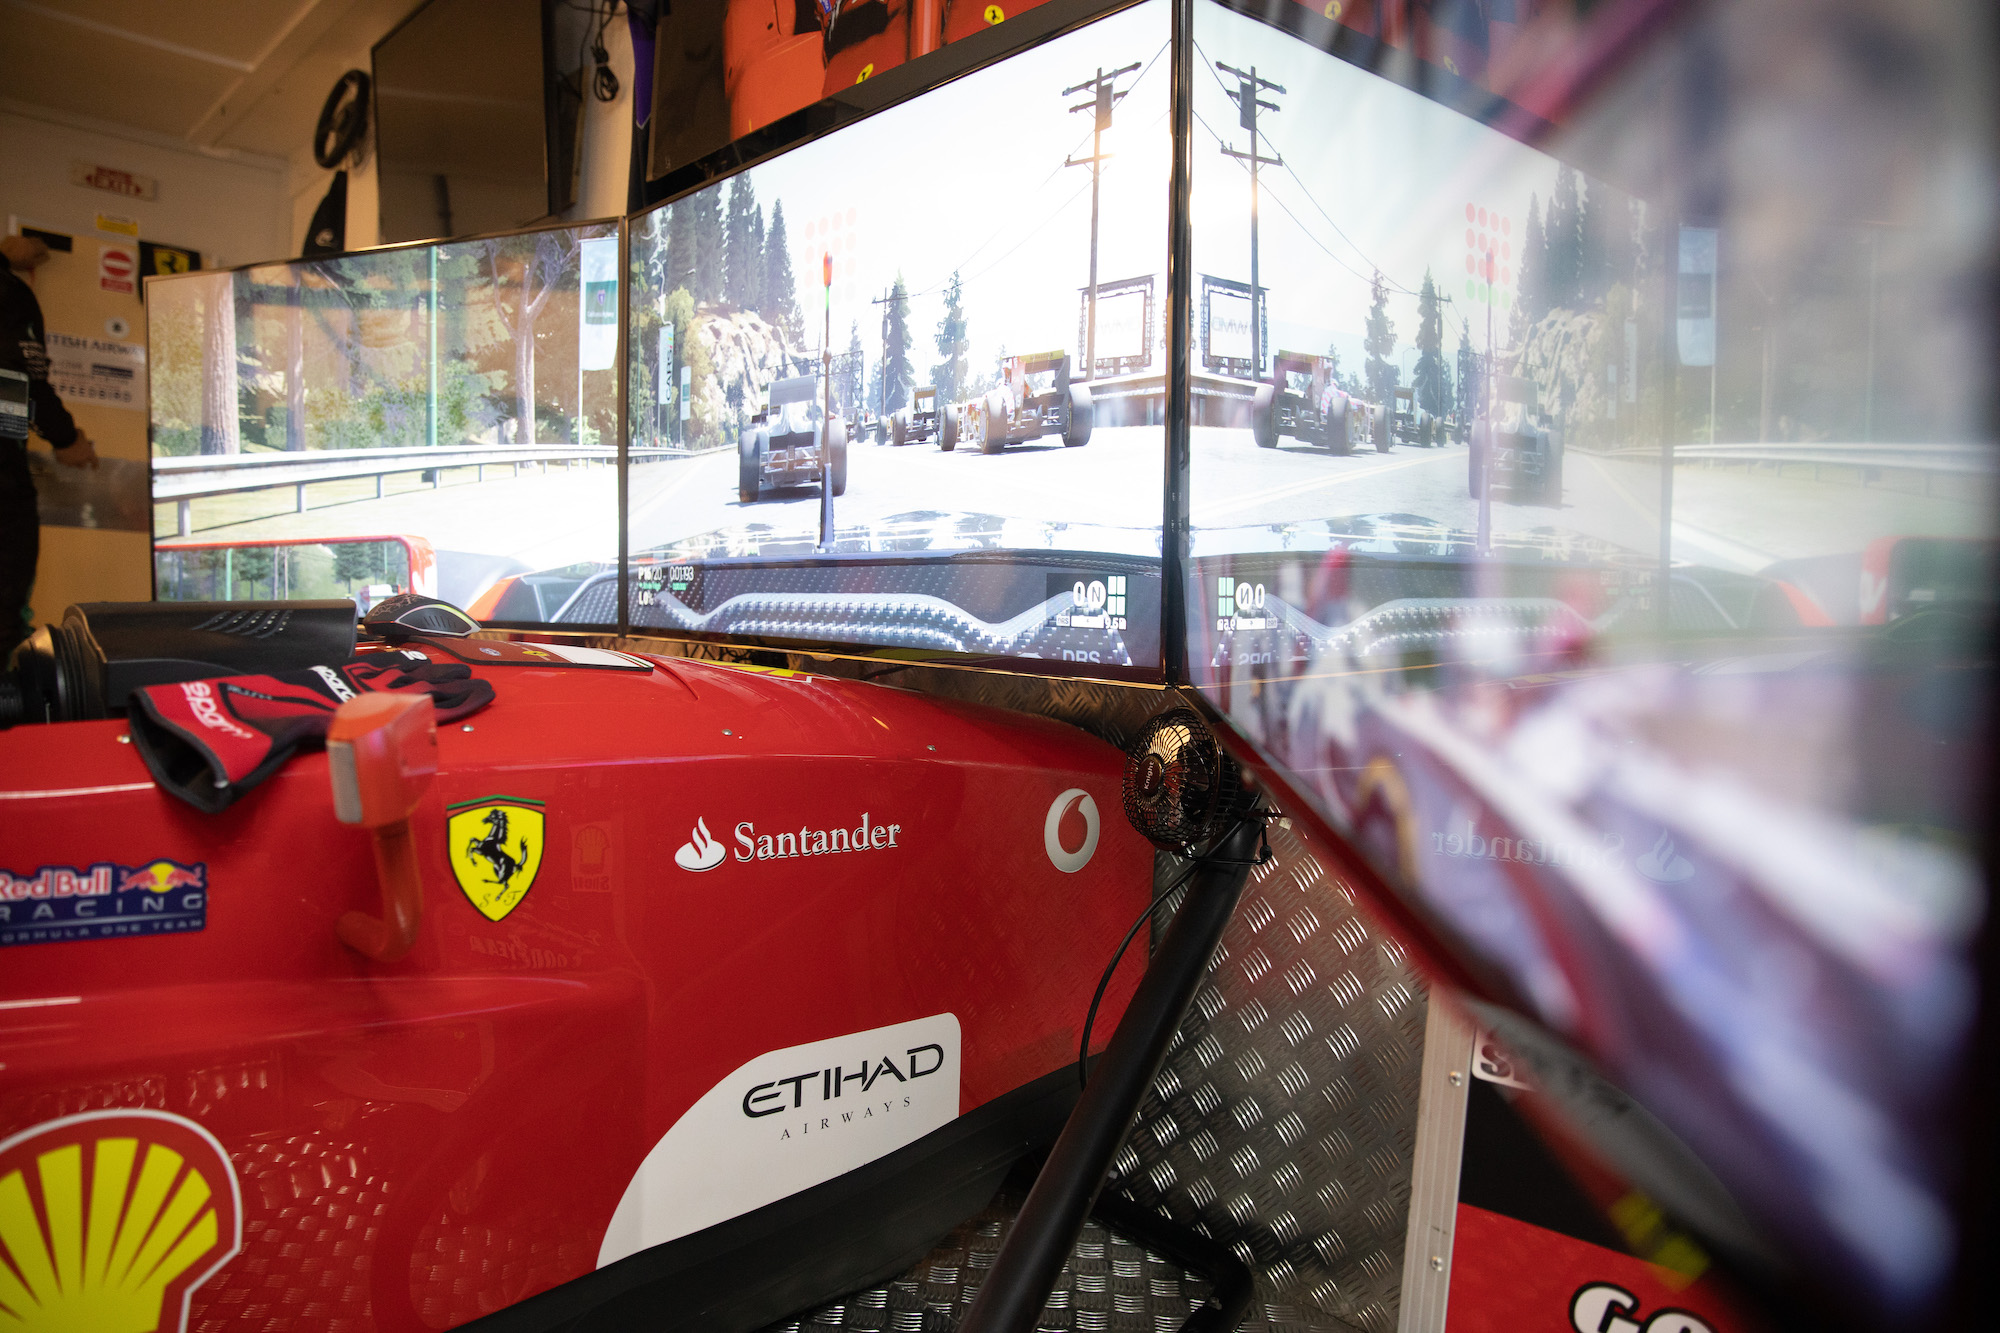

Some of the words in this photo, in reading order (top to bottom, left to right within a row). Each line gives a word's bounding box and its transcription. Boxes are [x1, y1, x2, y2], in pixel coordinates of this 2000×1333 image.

[1144, 761, 1155, 789] Knight
[733, 813, 901, 862] Santander
[0, 869, 52, 900] Red
[53, 866, 112, 897] Bull
[2, 928, 90, 943] ORMULA
[101, 923, 141, 935] ONE
[153, 919, 202, 930] TEAM
[743, 1043, 944, 1118] ETIHAD
[780, 1096, 911, 1140] AIRWAYS
